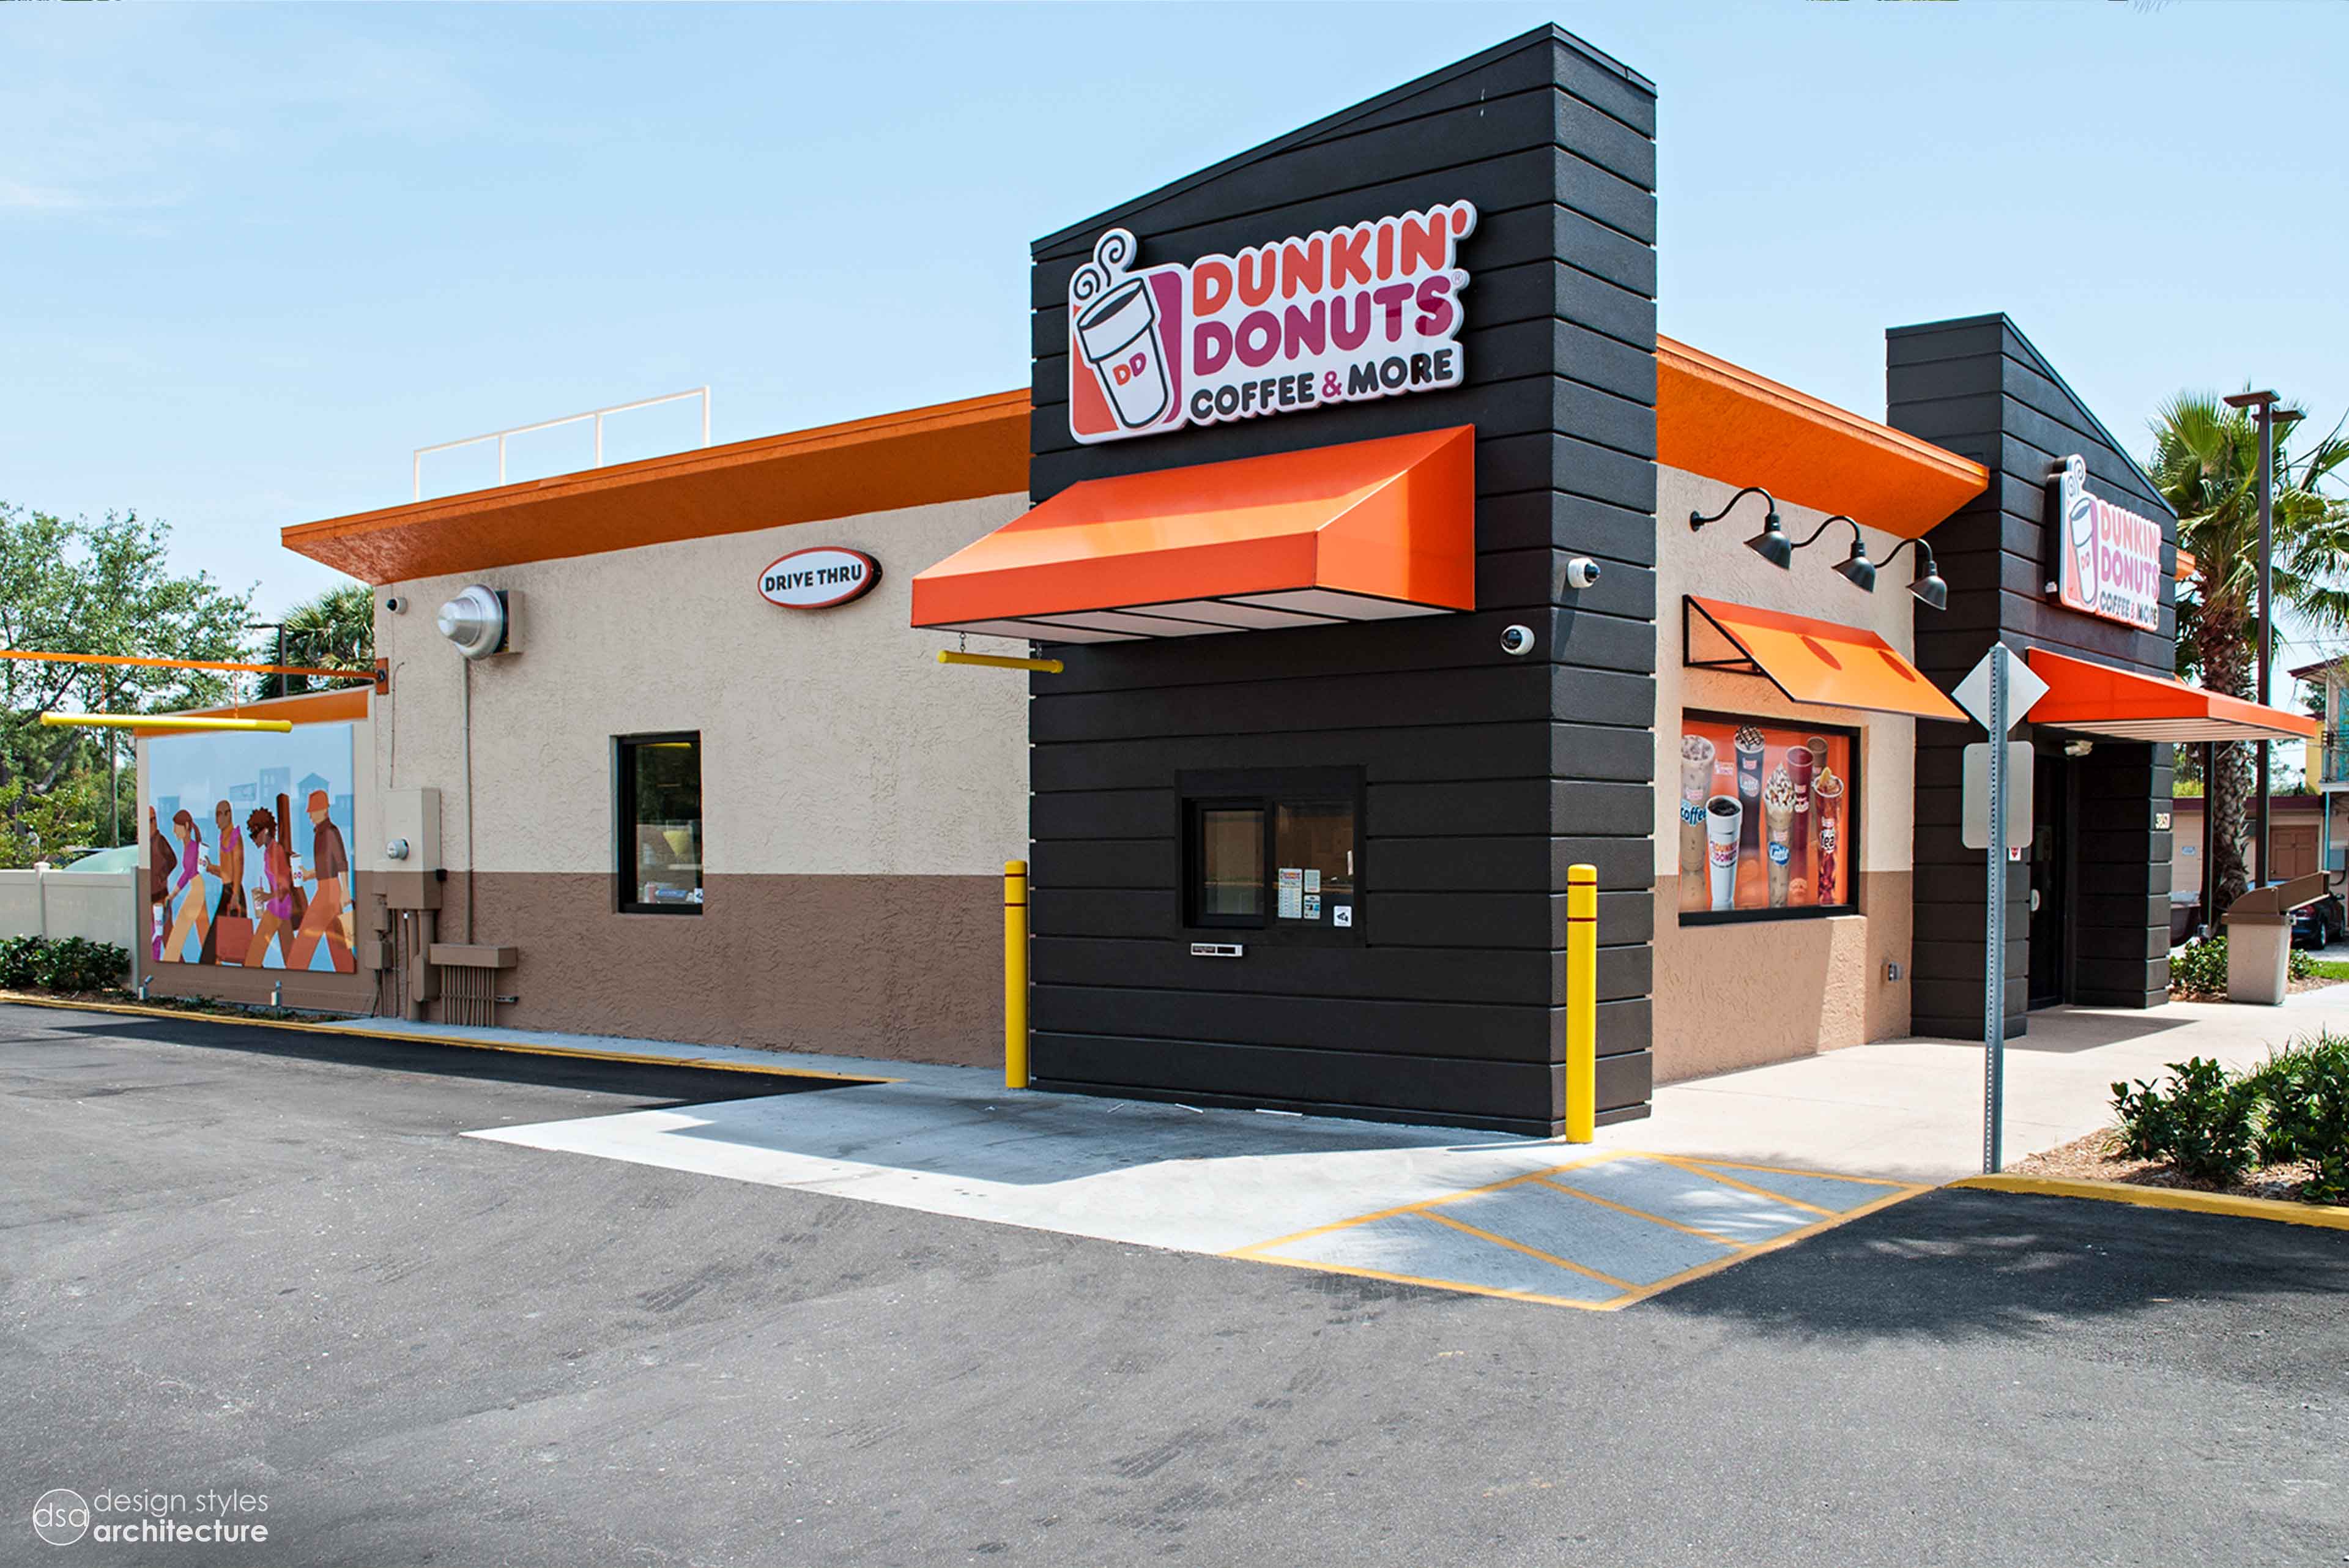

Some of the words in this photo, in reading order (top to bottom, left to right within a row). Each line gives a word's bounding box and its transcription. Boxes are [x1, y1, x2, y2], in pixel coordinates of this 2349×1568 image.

[1193, 208, 1466, 317] DUNKIN'
[1193, 275, 1453, 376] DONUTS
[1112, 352, 1147, 386] DD
[1190, 373, 1315, 419] COFFEE
[1322, 371, 1341, 398] &
[1348, 348, 1453, 395] MORE
[765, 571, 814, 592] DRIVE
[817, 563, 862, 585] THRU
[2101, 545, 2159, 600] DONUTS
[2099, 590, 2130, 618] COFFEE
